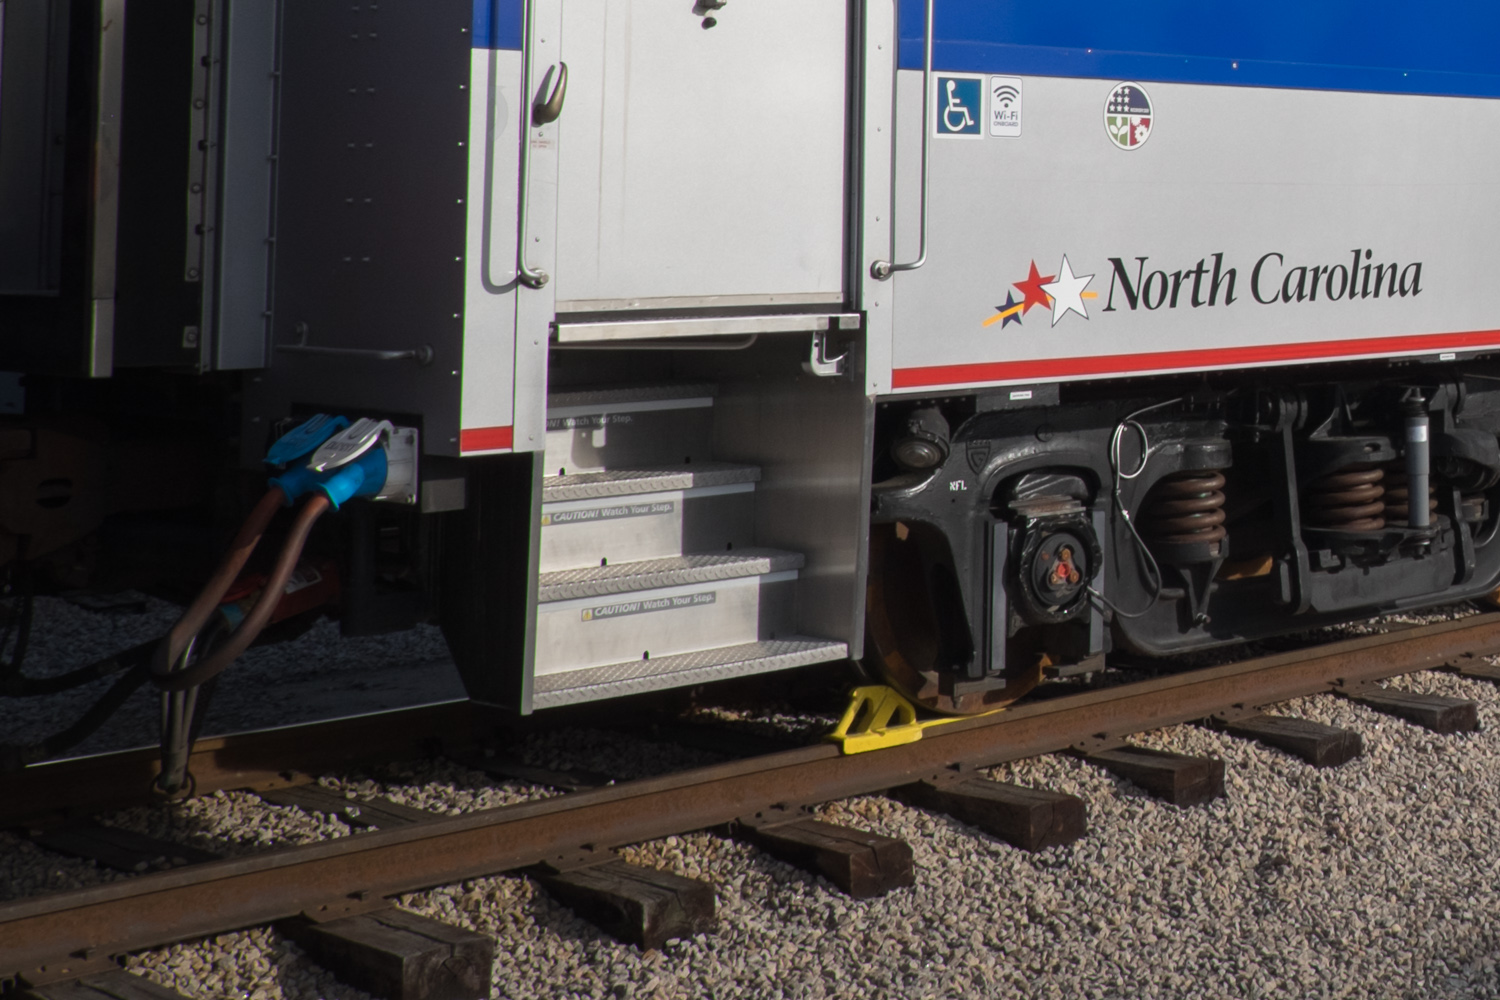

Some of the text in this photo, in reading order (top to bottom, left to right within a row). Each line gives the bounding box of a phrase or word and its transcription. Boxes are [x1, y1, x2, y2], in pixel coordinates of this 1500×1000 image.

[993, 110, 1018, 120] Wi-Fi
[1102, 248, 1423, 312] North Carolina
[553, 502, 673, 522] CAUTION! Watch Your Step.
[594, 593, 715, 617] CAUTION! Watch Your Step.
